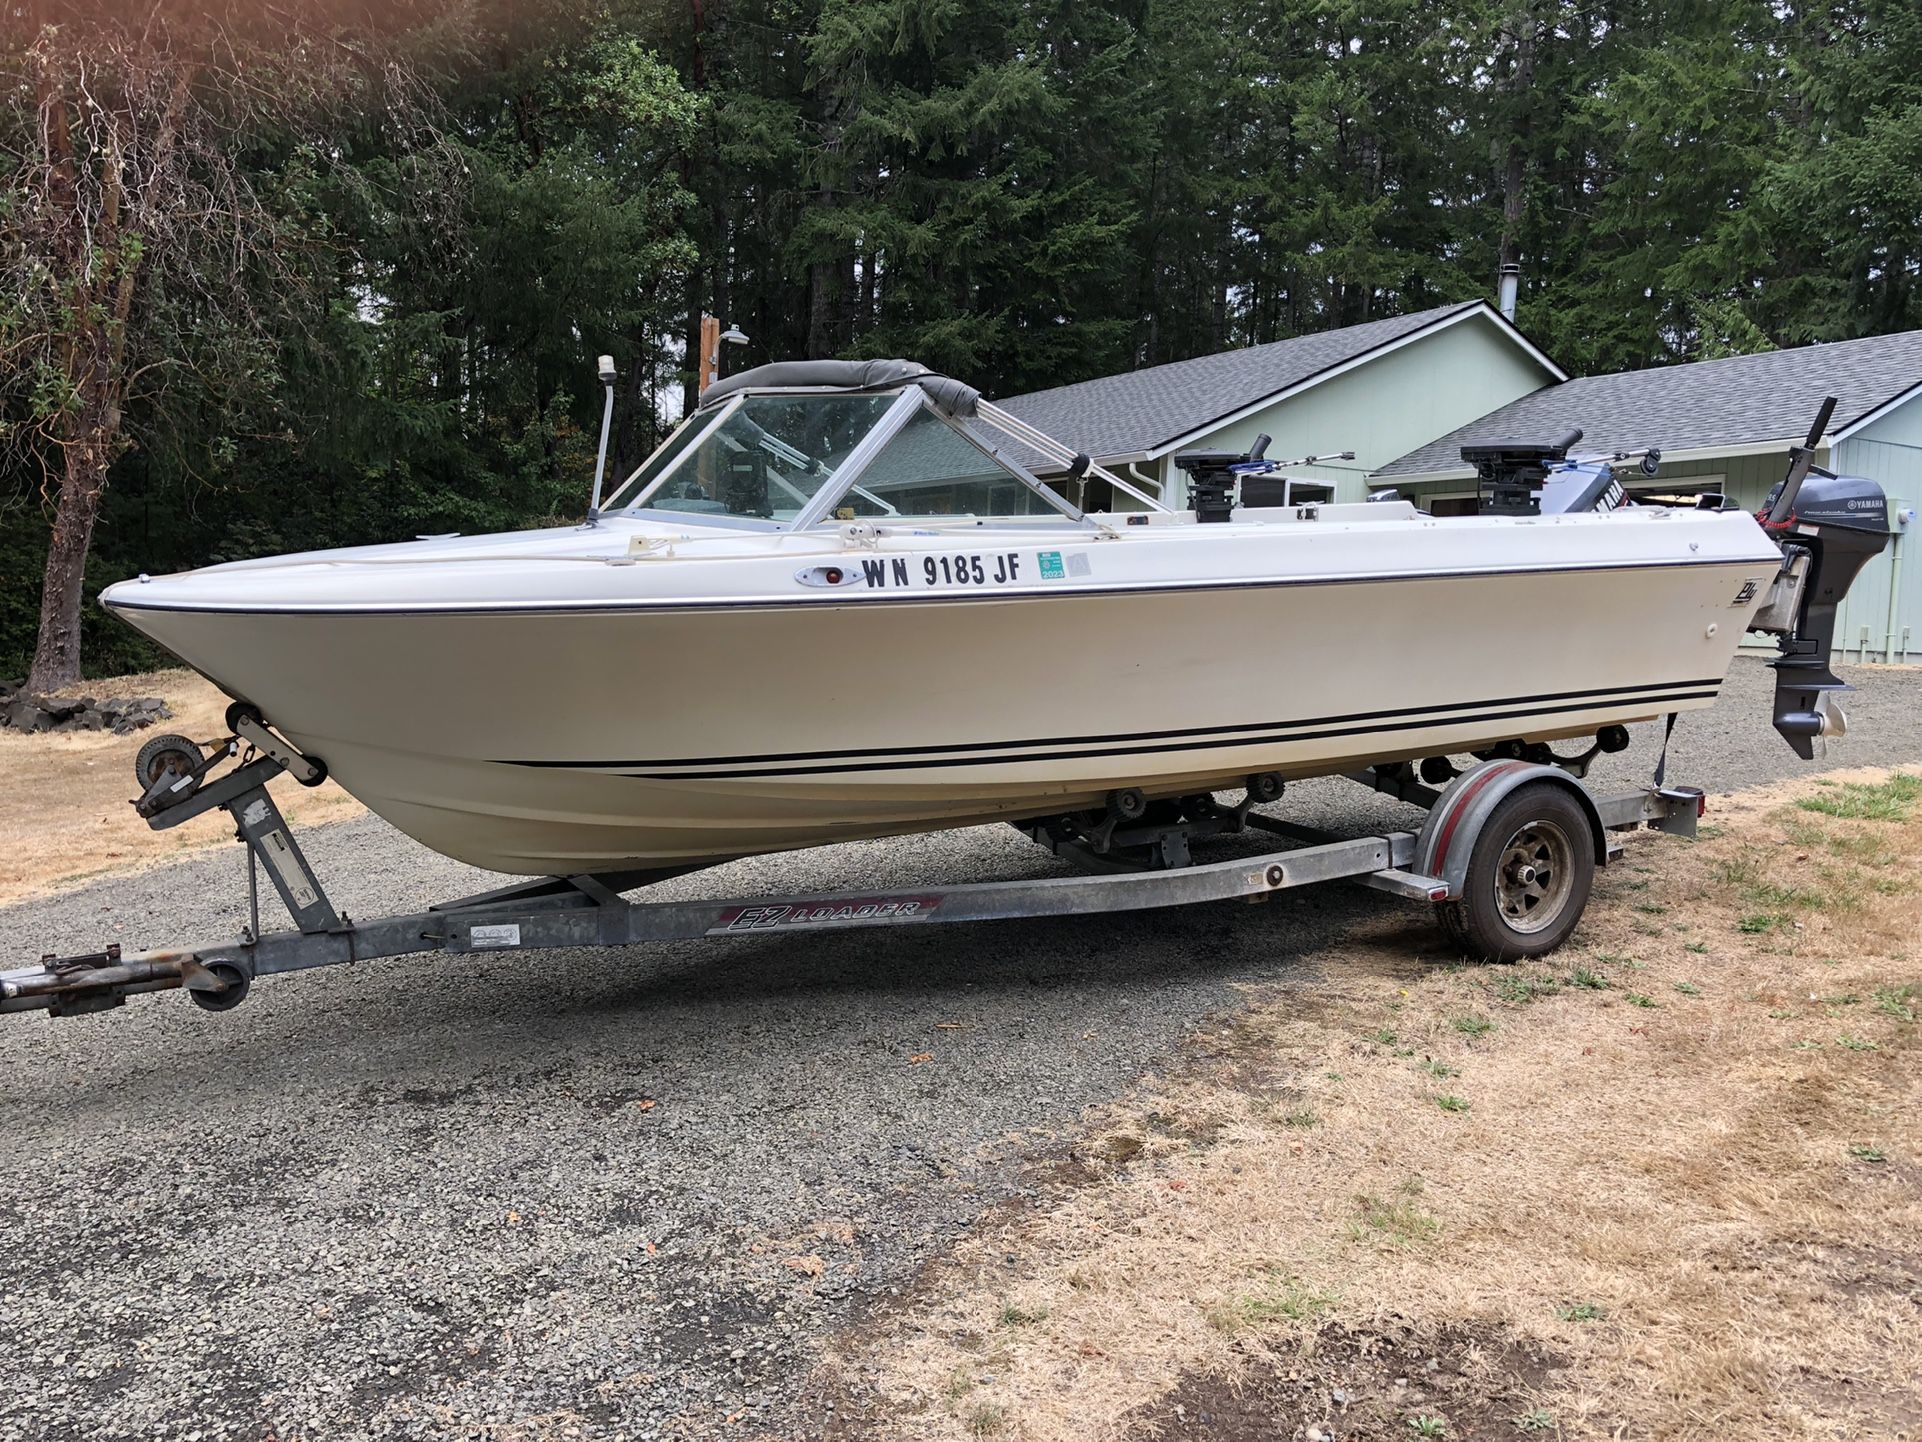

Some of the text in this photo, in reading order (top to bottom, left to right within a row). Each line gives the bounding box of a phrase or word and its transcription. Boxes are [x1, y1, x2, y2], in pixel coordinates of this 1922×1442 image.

[1591, 479, 1624, 512] MAHA
[1857, 499, 1884, 509] YAMAHA
[861, 558, 909, 588] WN
[923, 555, 985, 586] 9185
[993, 553, 1020, 584] JF
[1042, 570, 1064, 579] 2023
[728, 902, 920, 930] EZ LOADER
